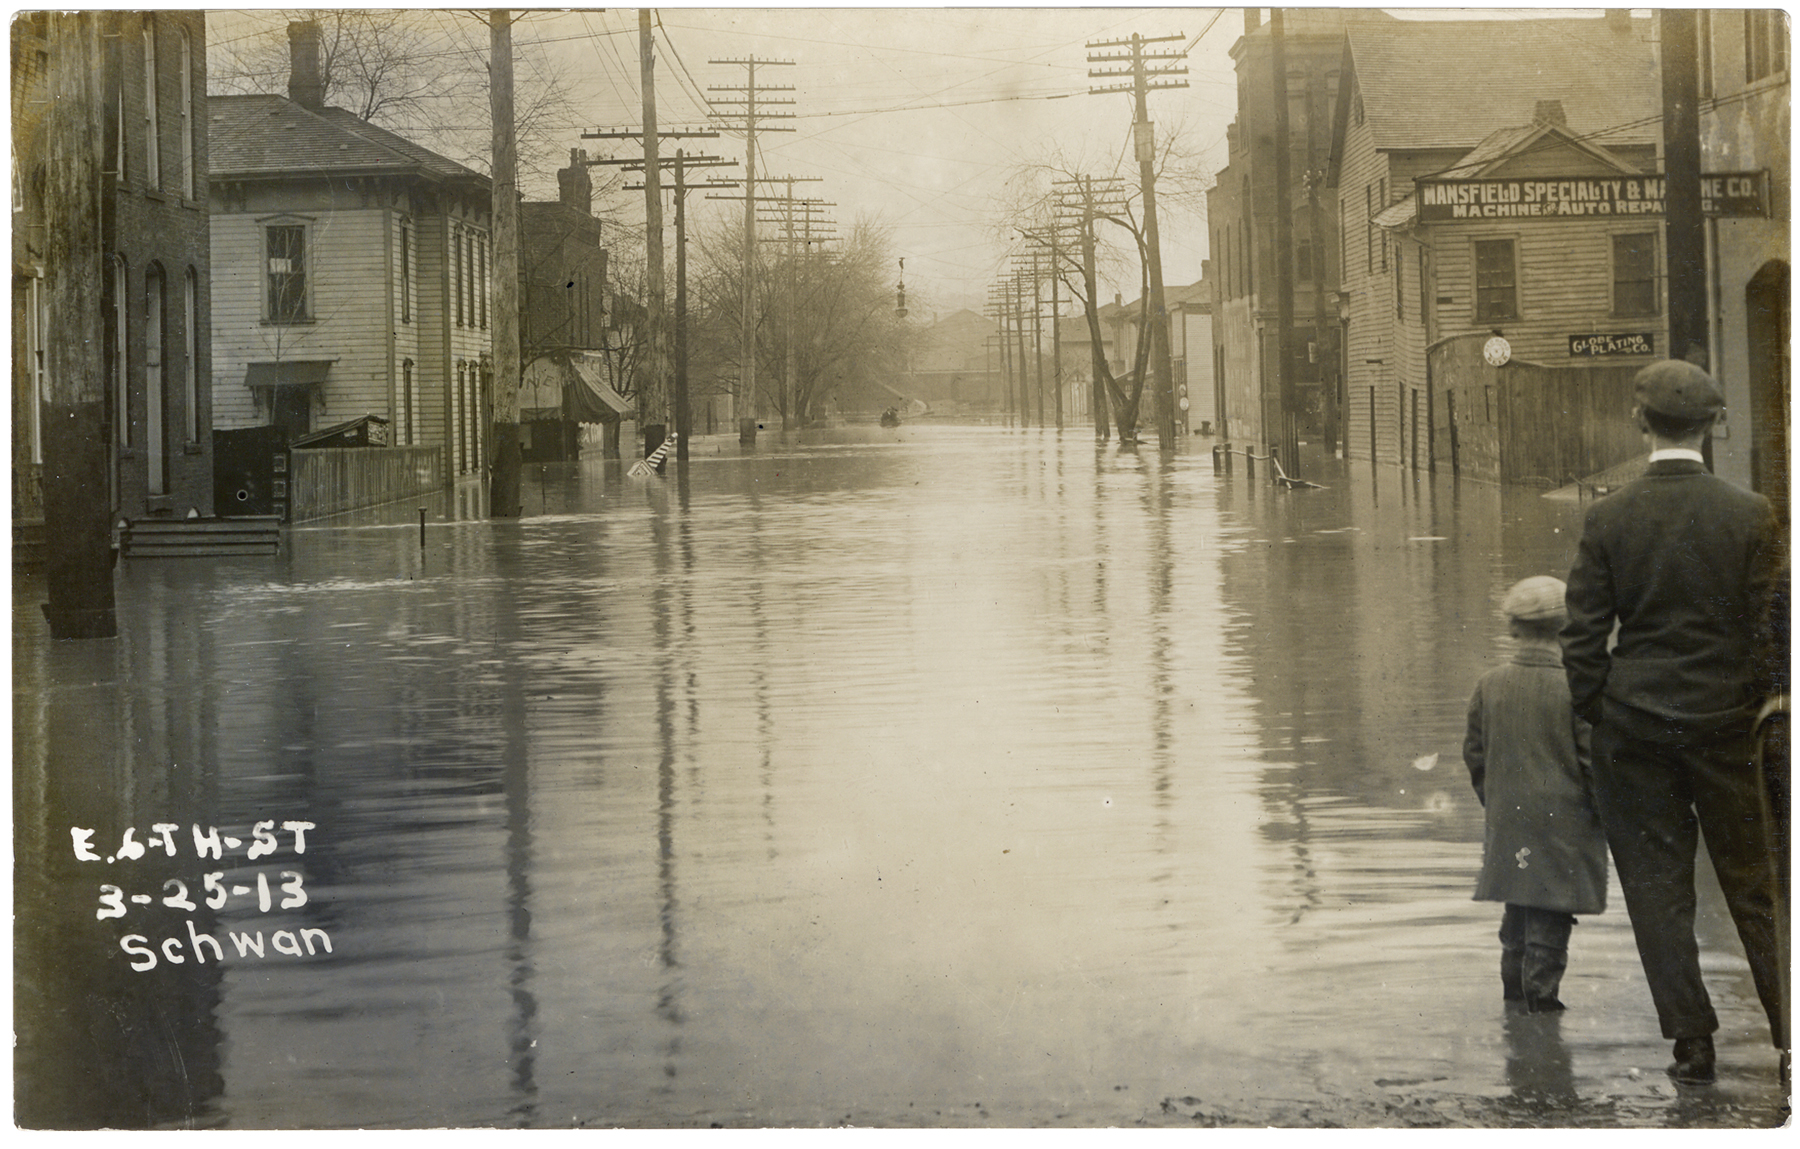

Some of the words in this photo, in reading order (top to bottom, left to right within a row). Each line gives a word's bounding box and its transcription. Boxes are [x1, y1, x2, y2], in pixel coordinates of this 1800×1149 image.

[1424, 182, 1520, 205] MANSFIELD
[1524, 180, 1621, 202] SPECIALTY
[1627, 180, 1641, 200] &
[1644, 178, 1723, 200] MANE
[1727, 177, 1757, 197] CO.
[1453, 203, 1542, 217] MACHINE
[1558, 200, 1611, 215] AUTO
[1615, 199, 1720, 214] REPAG.
[1572, 335, 1614, 353] GLOBE
[1591, 335, 1644, 355] PLATING
[1632, 343, 1651, 353] CO.
